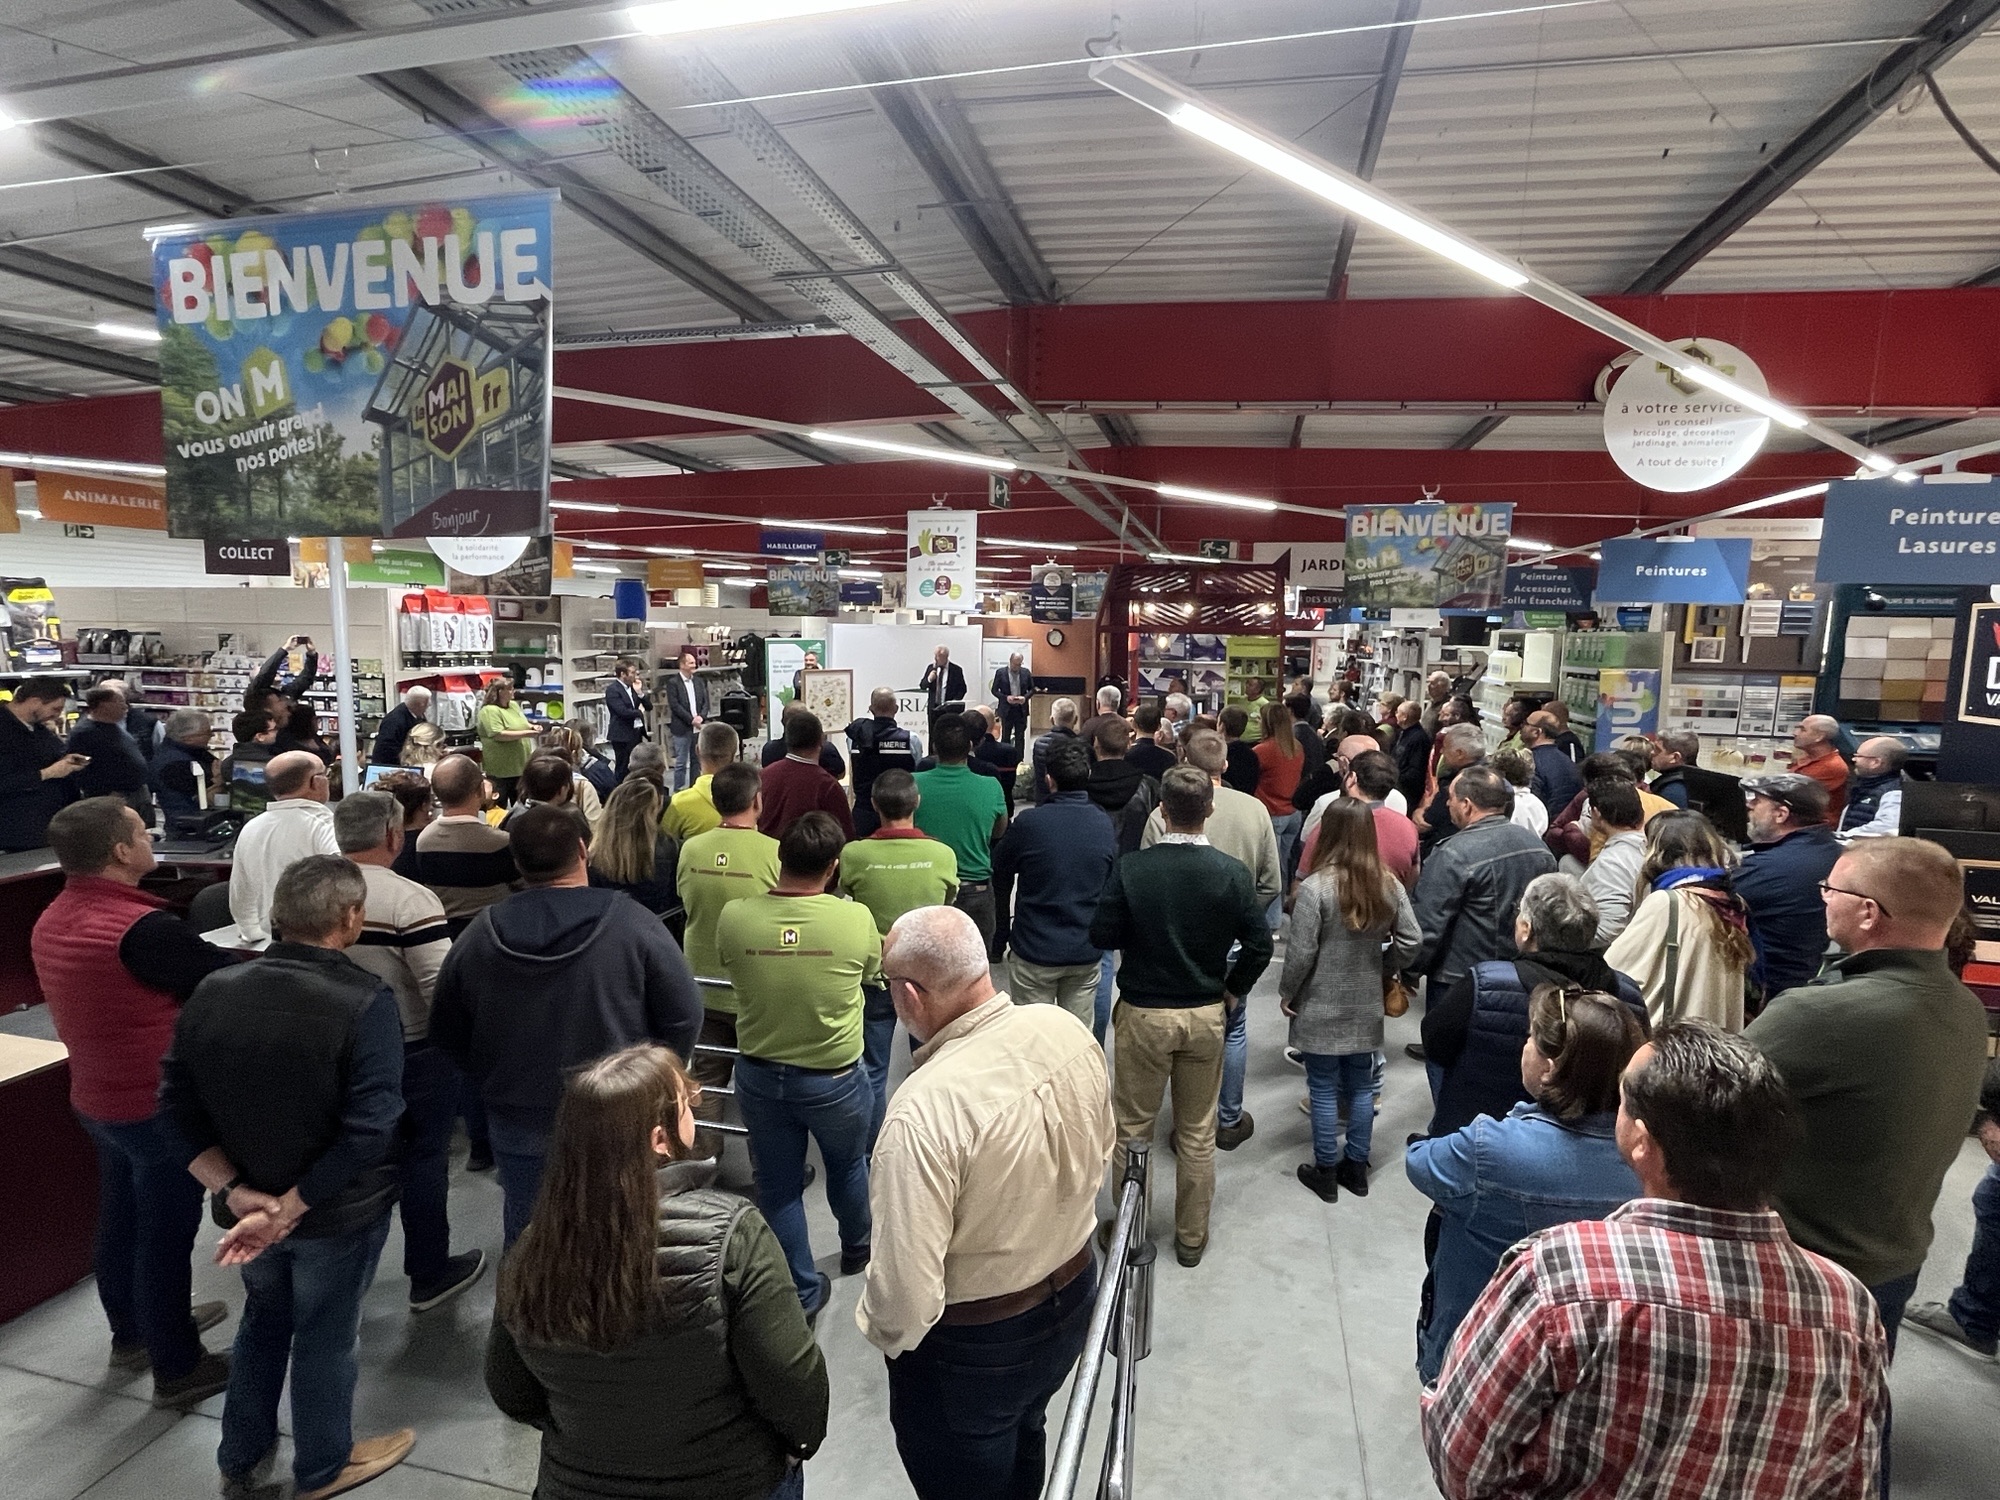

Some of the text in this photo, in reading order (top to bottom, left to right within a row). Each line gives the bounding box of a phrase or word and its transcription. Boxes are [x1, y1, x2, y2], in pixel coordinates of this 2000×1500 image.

[169, 228, 542, 324] BIENVENUE
[194, 360, 285, 424] ON M
[1636, 403, 1678, 414] votre
[1684, 401, 1743, 413] service
[1674, 417, 1713, 427] conseil
[176, 401, 325, 459] vous ouvrir grand
[1682, 438, 1734, 447] animalerie
[236, 451, 266, 473] nos
[1648, 458, 1671, 467] tout
[1674, 456, 1689, 467] de
[1691, 457, 1718, 467] suite
[63, 489, 162, 511] ANIMALERIE
[432, 507, 480, 534] Bonjour
[1351, 513, 1507, 537] BIENVENUE
[1898, 536, 1997, 554] Lasures
[219, 546, 275, 560] COLLECT
[460, 552, 505, 562] performance
[1355, 556, 1378, 570] ON
[769, 569, 839, 582] BIENVENUE
[1520, 572, 1568, 581] Peintures
[1635, 564, 1708, 577] Peintures
[1514, 584, 1572, 594] Accessoires
[1502, 596, 1527, 606] Colle
